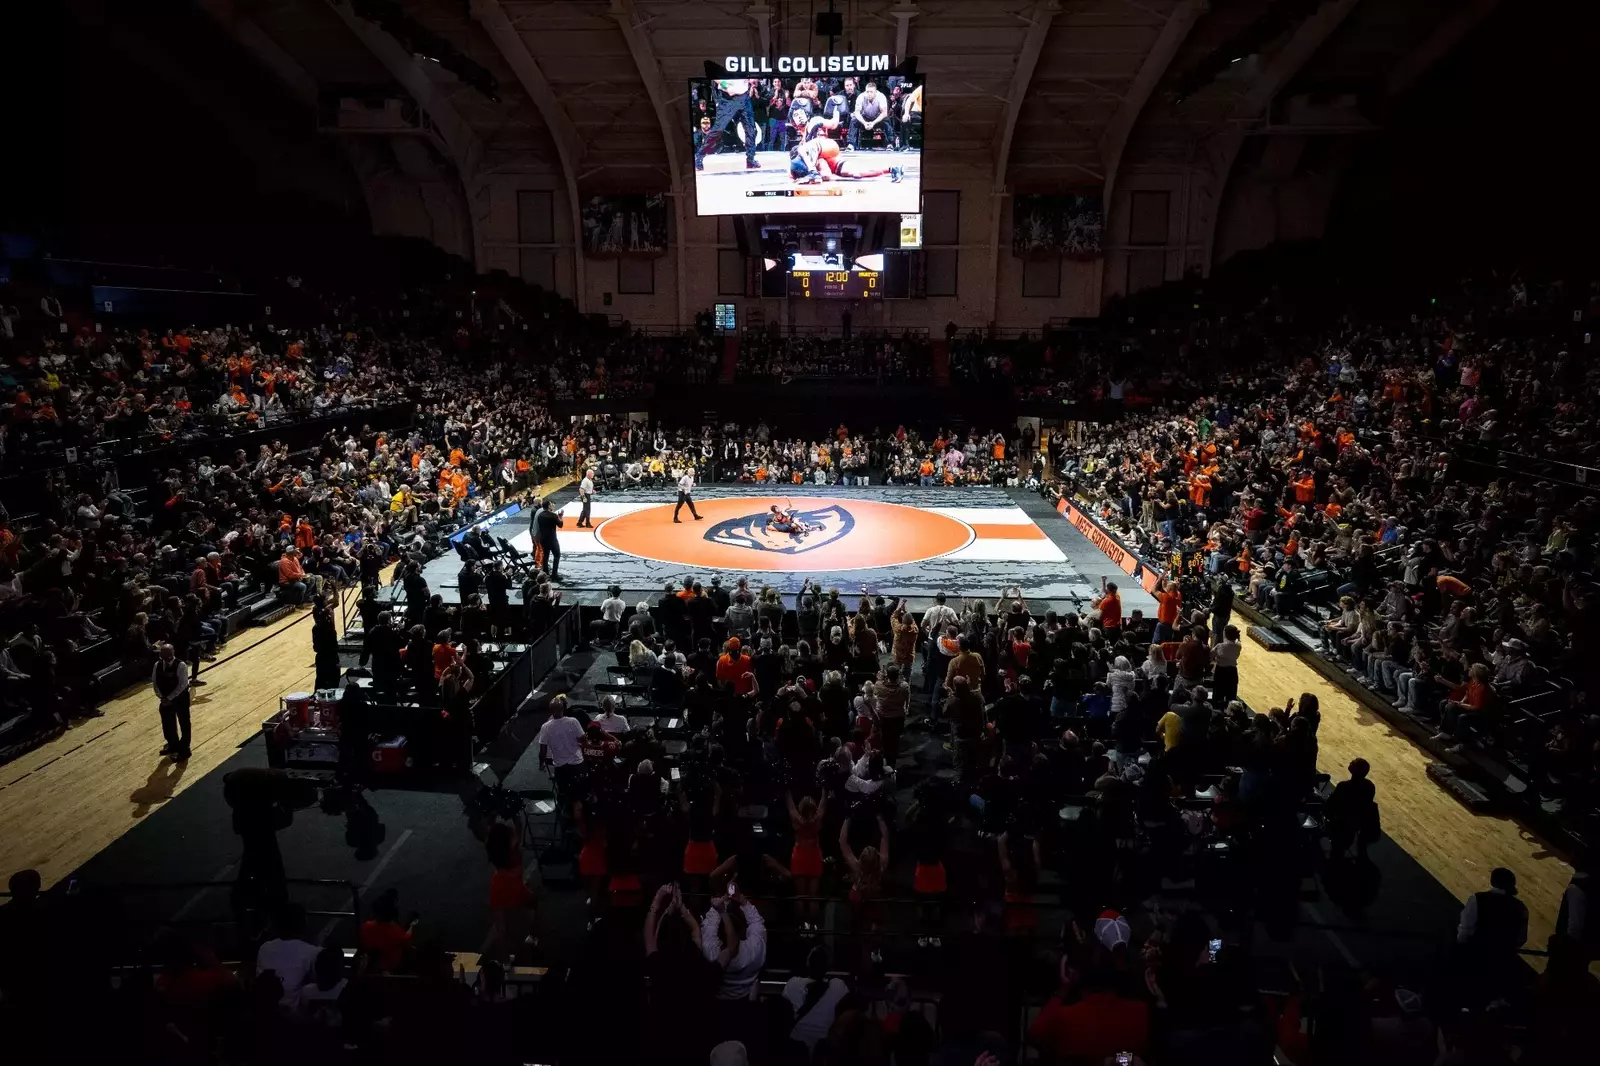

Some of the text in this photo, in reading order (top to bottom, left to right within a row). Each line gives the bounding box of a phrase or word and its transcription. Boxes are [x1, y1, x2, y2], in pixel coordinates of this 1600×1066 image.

[725, 55, 889, 73] GILL COLISEUM
[826, 272, 849, 282] 12:00
[803, 278, 809, 288] 0
[870, 278, 876, 288] 0
[1092, 529, 1125, 566] SPONSOR
[322, 708, 330, 716] G
[371, 750, 383, 762] G
